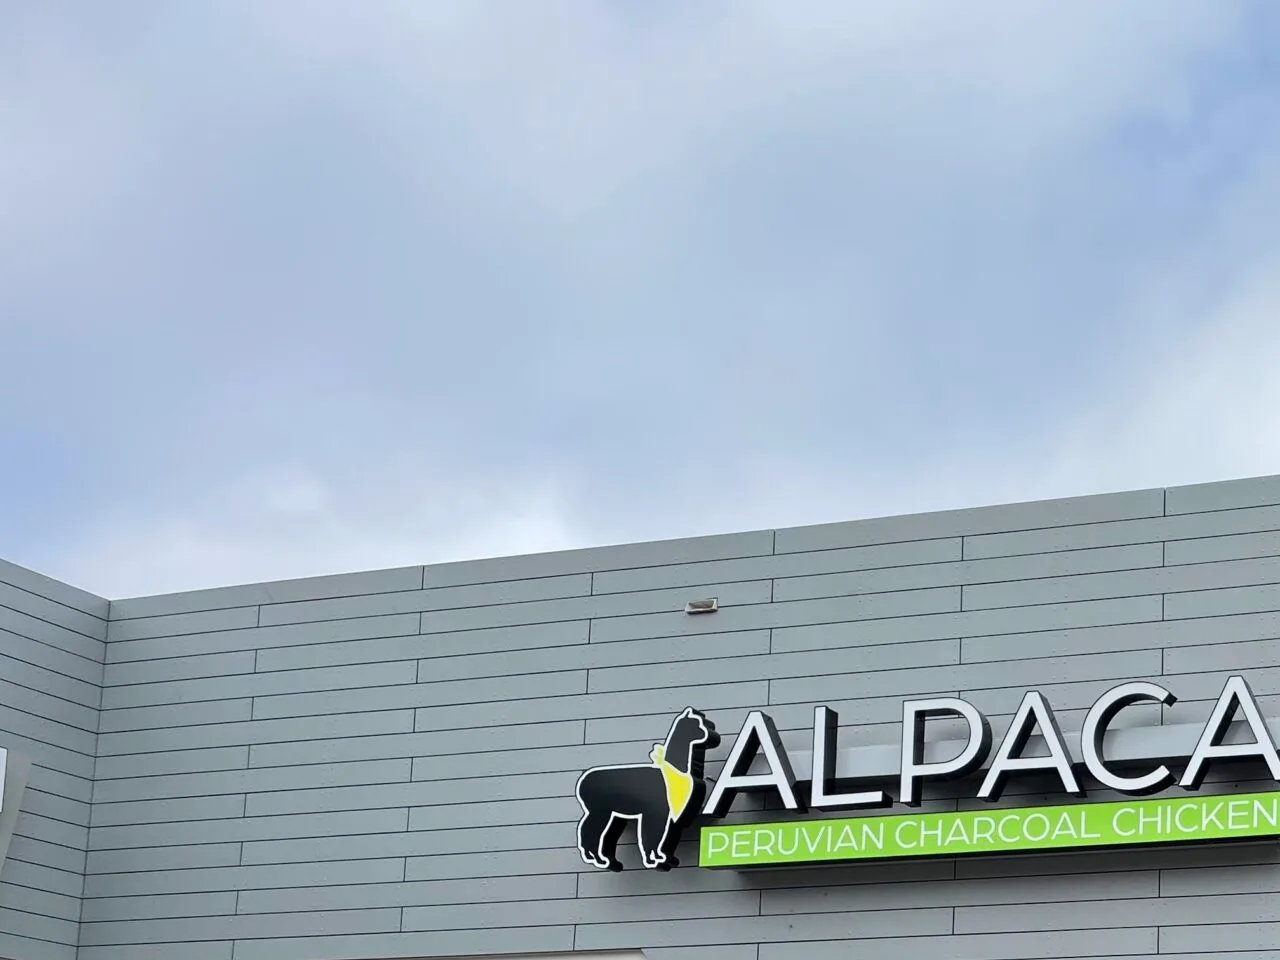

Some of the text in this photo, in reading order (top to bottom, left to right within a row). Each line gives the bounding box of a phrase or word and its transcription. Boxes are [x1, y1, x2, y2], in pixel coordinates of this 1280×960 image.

[706, 799, 1279, 859] PERUVIAN CHARCOAL CHICKEN
